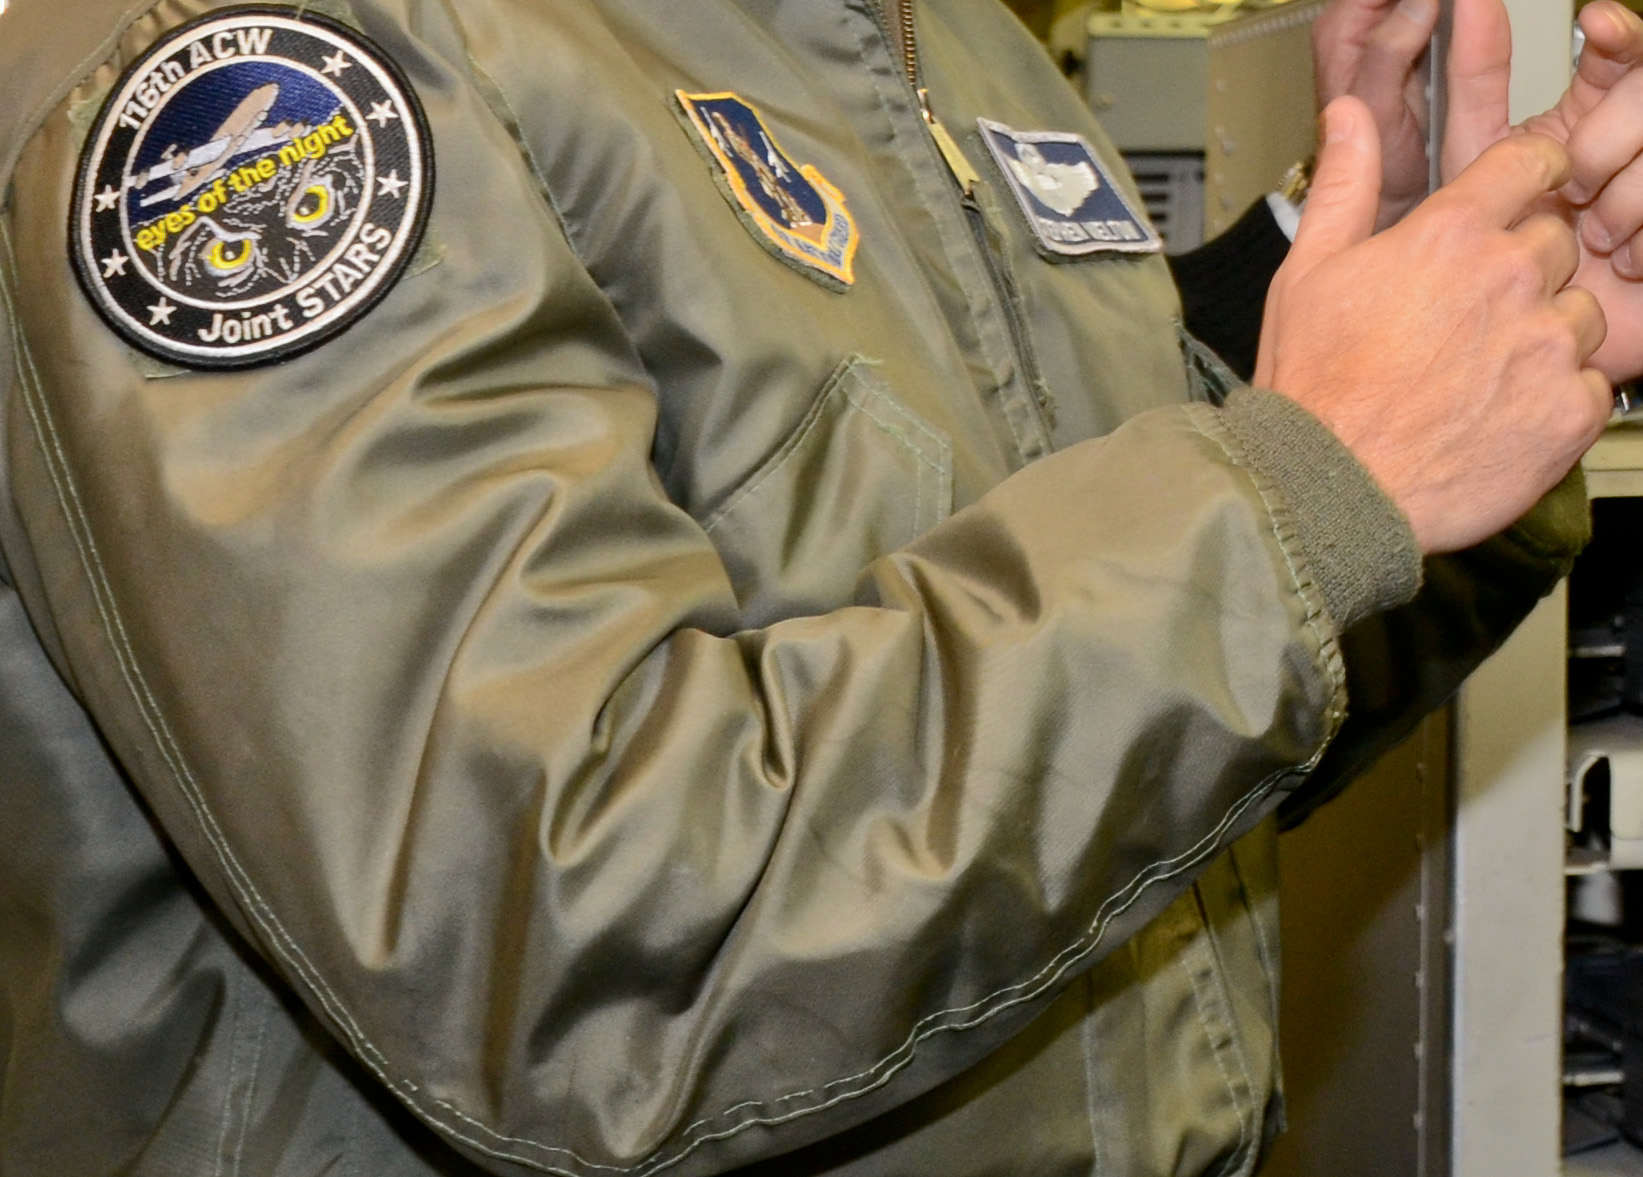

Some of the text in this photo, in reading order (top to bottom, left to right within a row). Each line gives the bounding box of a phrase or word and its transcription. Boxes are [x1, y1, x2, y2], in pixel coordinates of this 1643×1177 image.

[119, 28, 273, 130] 116th ACW
[136, 115, 354, 251] eyes of the night
[198, 222, 392, 344] Joint STARS
